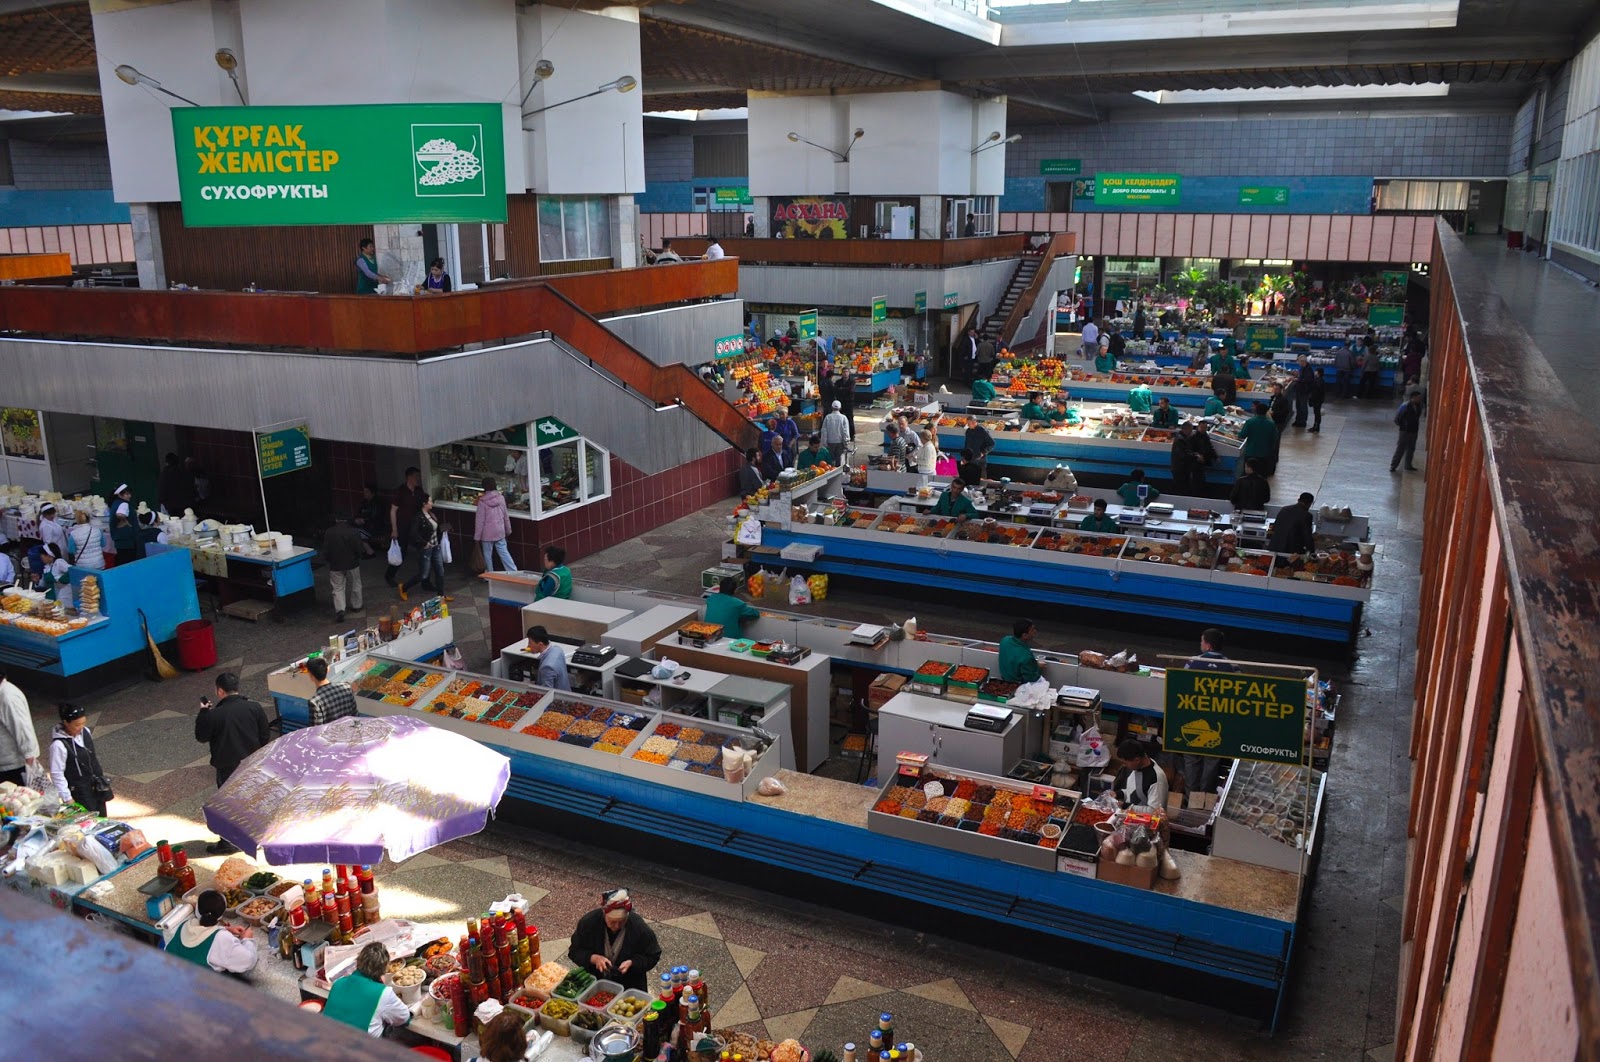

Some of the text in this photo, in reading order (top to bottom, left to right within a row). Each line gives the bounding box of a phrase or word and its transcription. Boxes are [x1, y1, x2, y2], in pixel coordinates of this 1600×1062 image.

[193, 124, 306, 152] ҚҰРҒАҚ
[197, 150, 339, 174] ЖЕМІСТЕР
[200, 184, 328, 200] СУХОФРУКТЫ
[774, 201, 848, 220] АСХАНА
[1194, 676, 1277, 702] ҚҰРҒАҚ
[1177, 693, 1295, 719] ЖЕМІСТЕР
[1240, 743, 1298, 758] СУХОФРУКТЫ
